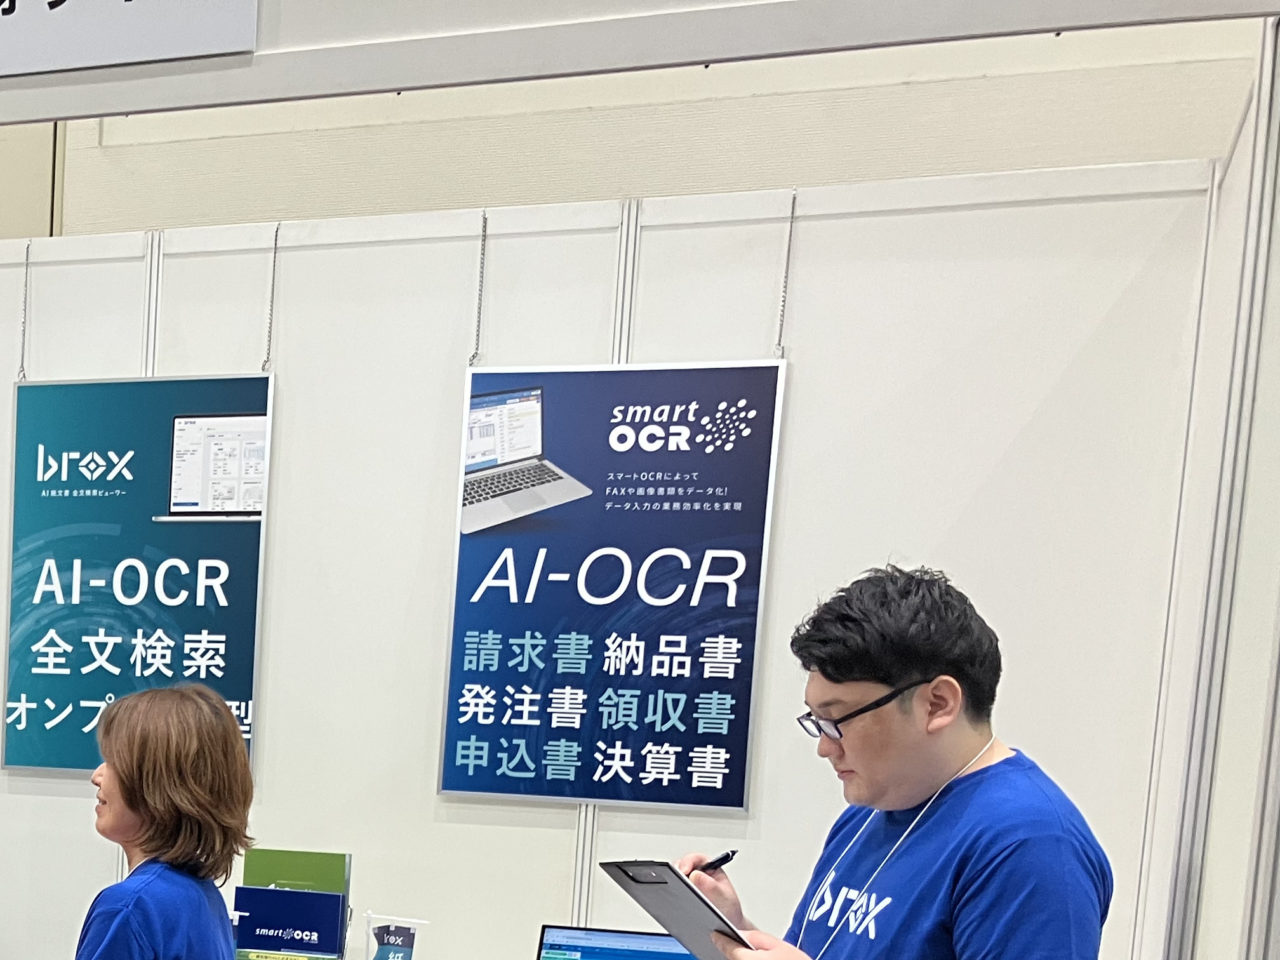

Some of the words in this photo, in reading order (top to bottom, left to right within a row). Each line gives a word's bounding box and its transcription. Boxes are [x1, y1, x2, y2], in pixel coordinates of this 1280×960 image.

[610, 400, 700, 423] smart
[36, 443, 135, 482] brox
[608, 424, 691, 453] OCR
[32, 557, 230, 607] AI-OCR
[469, 546, 747, 608] AI-OCR
[30, 627, 227, 679] 全文検索
[463, 629, 593, 675] 請求書
[602, 631, 743, 679] 納品書
[457, 683, 588, 729] 発注書
[597, 687, 737, 735] 領収書
[455, 735, 582, 782] 申込書
[591, 740, 731, 789] 決算書
[808, 869, 893, 941] brox
[255, 927, 283, 938] smart
[293, 930, 319, 941] OCR
